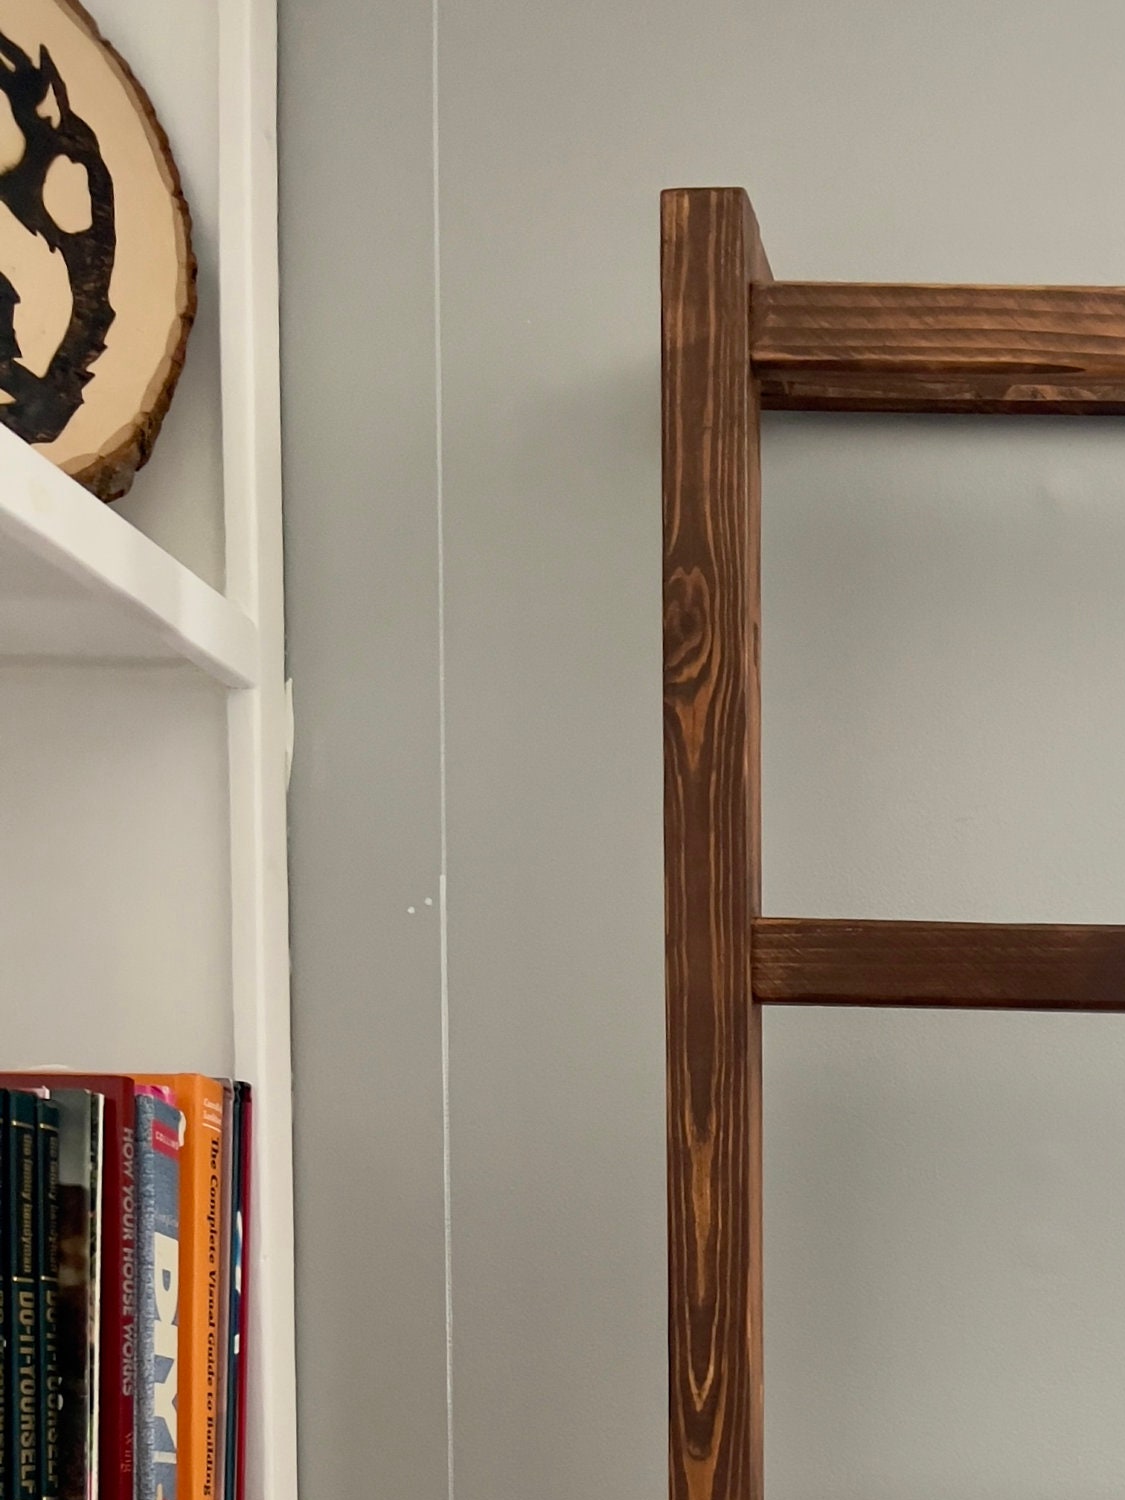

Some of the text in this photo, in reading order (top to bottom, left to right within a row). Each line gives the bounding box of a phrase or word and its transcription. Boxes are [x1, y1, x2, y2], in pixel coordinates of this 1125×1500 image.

[209, 1137, 220, 1170] The
[208, 1173, 220, 1264] Complete
[122, 1127, 134, 1397] HOW YOUR HOUSE WORKS
[207, 1270, 218, 1327] Visual
[18, 1290, 36, 1495] DO-IT-YOURSELF
[206, 1332, 217, 1386] Guide
[205, 1391, 214, 1412] to
[203, 1416, 215, 1496] Building
